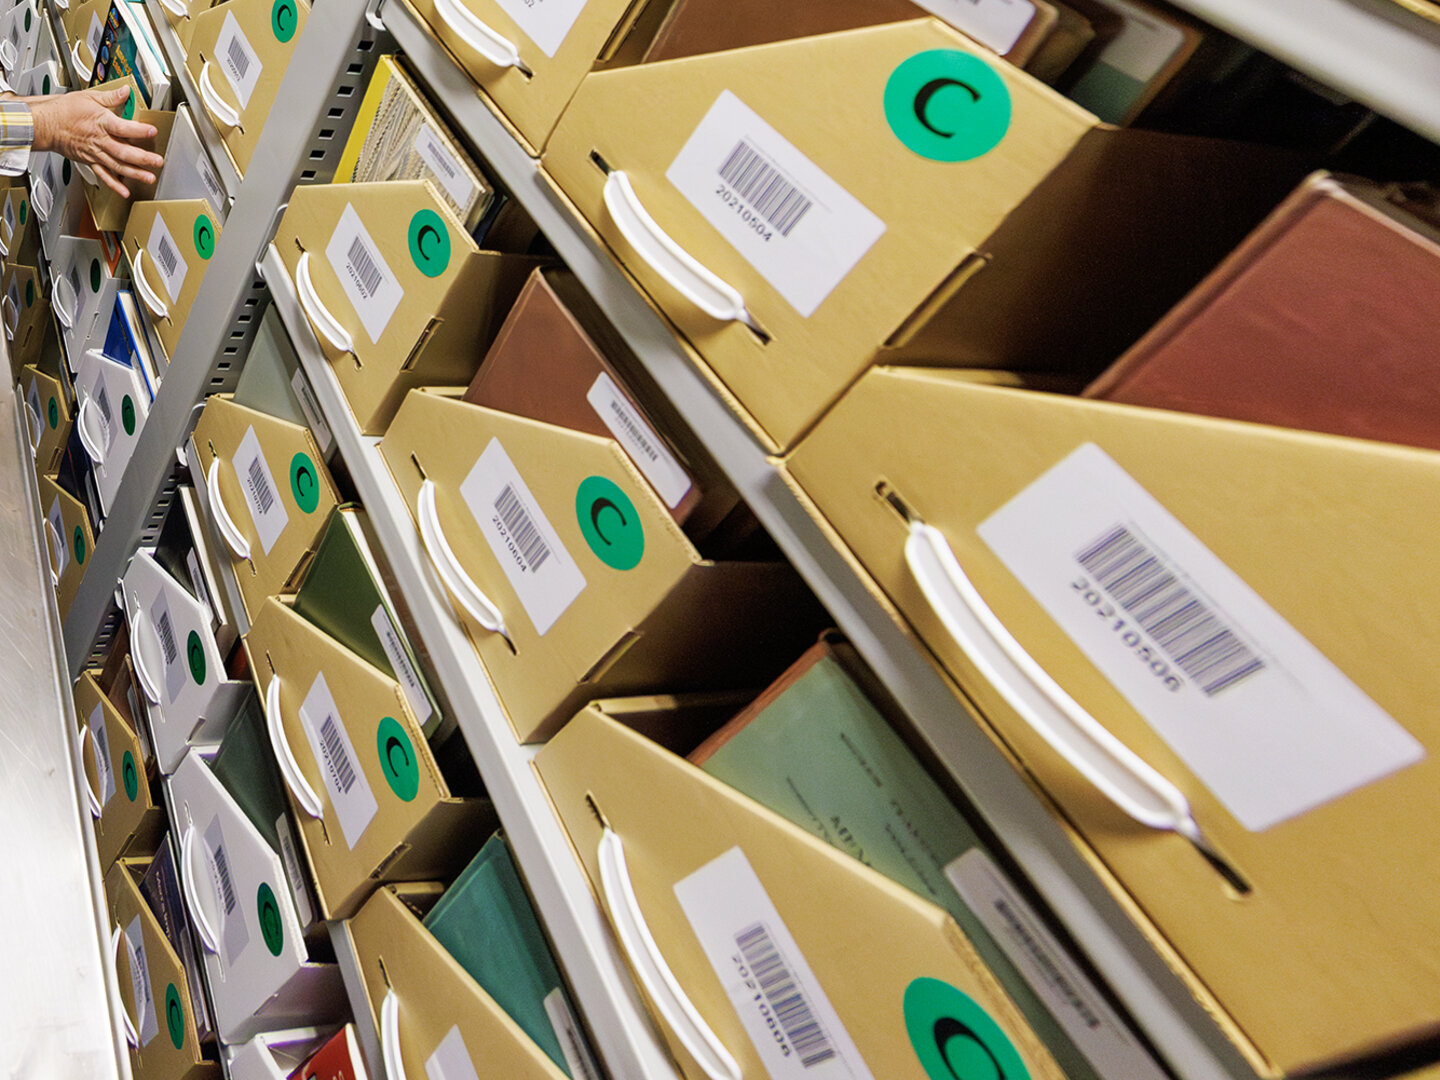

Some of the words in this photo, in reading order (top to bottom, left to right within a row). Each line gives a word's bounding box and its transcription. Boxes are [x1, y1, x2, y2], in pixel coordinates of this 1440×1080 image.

[277, 5, 291, 31] C
[913, 78, 980, 138] C
[713, 182, 775, 242] 20210504
[199, 226, 210, 250] C
[418, 225, 440, 260] C
[344, 262, 368, 299] 20210602
[297, 466, 312, 496] C
[491, 514, 527, 572] 20210604
[591, 498, 626, 545] C
[1068, 572, 1186, 694] 20210506
[318, 741, 342, 793] 20210704
[386, 736, 409, 777] C
[731, 953, 792, 1057] 20210606
[933, 1017, 1006, 1080] C
